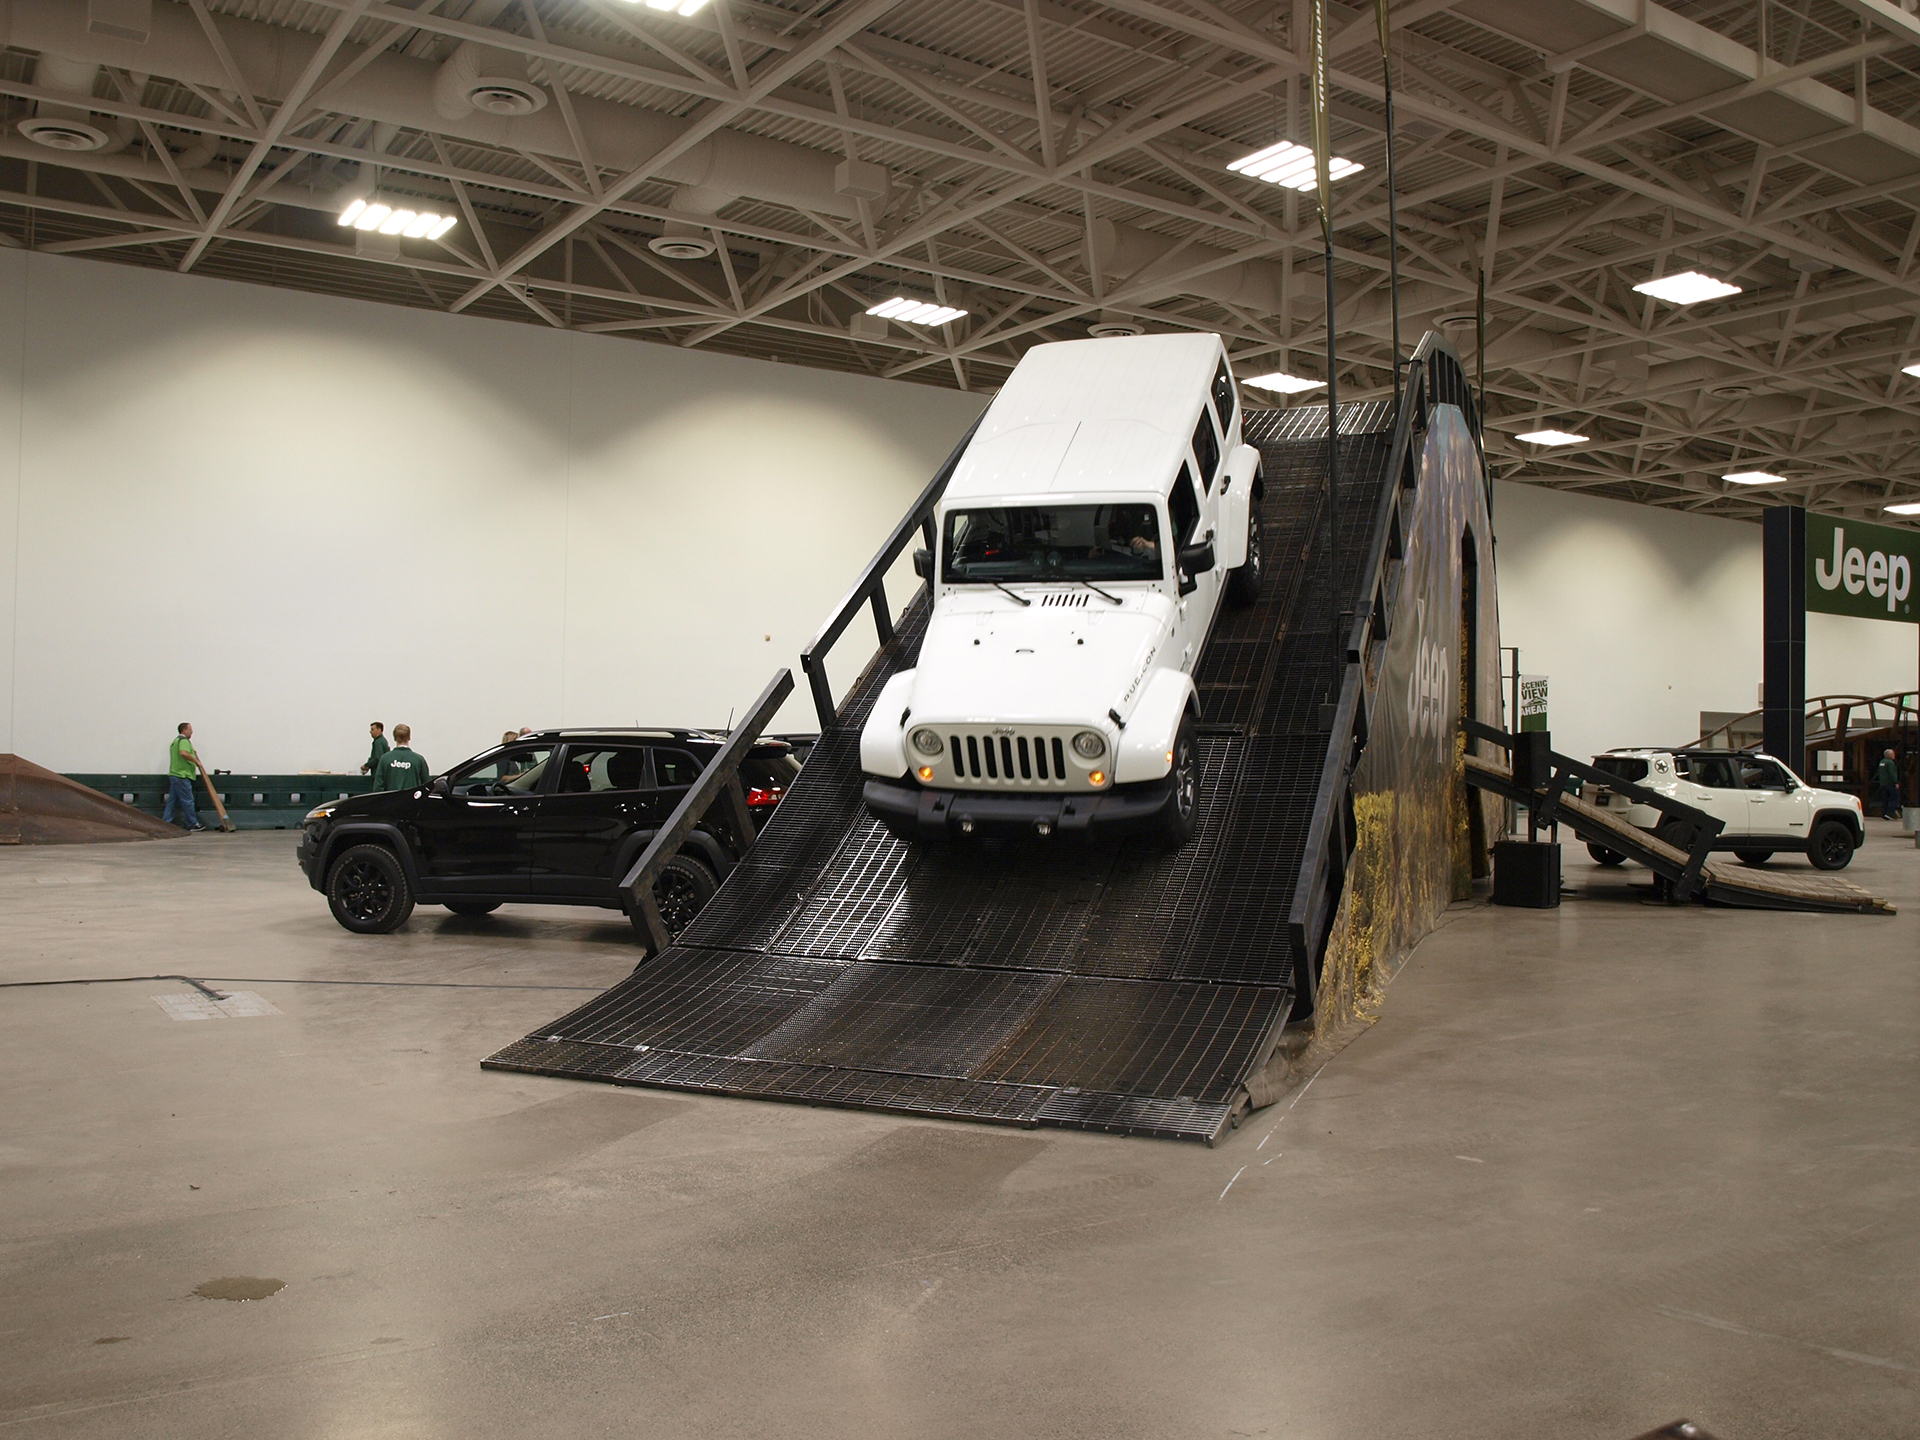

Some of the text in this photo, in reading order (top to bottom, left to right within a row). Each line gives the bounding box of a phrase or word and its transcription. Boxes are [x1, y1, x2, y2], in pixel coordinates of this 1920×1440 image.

[1815, 527, 1911, 612] Jeep
[1407, 598, 1449, 763] Jeep
[1521, 680, 1547, 690] SCENIC
[1521, 687, 1548, 700] VIEW
[1521, 704, 1547, 716] AHEAD
[390, 759, 411, 770] Jeep
